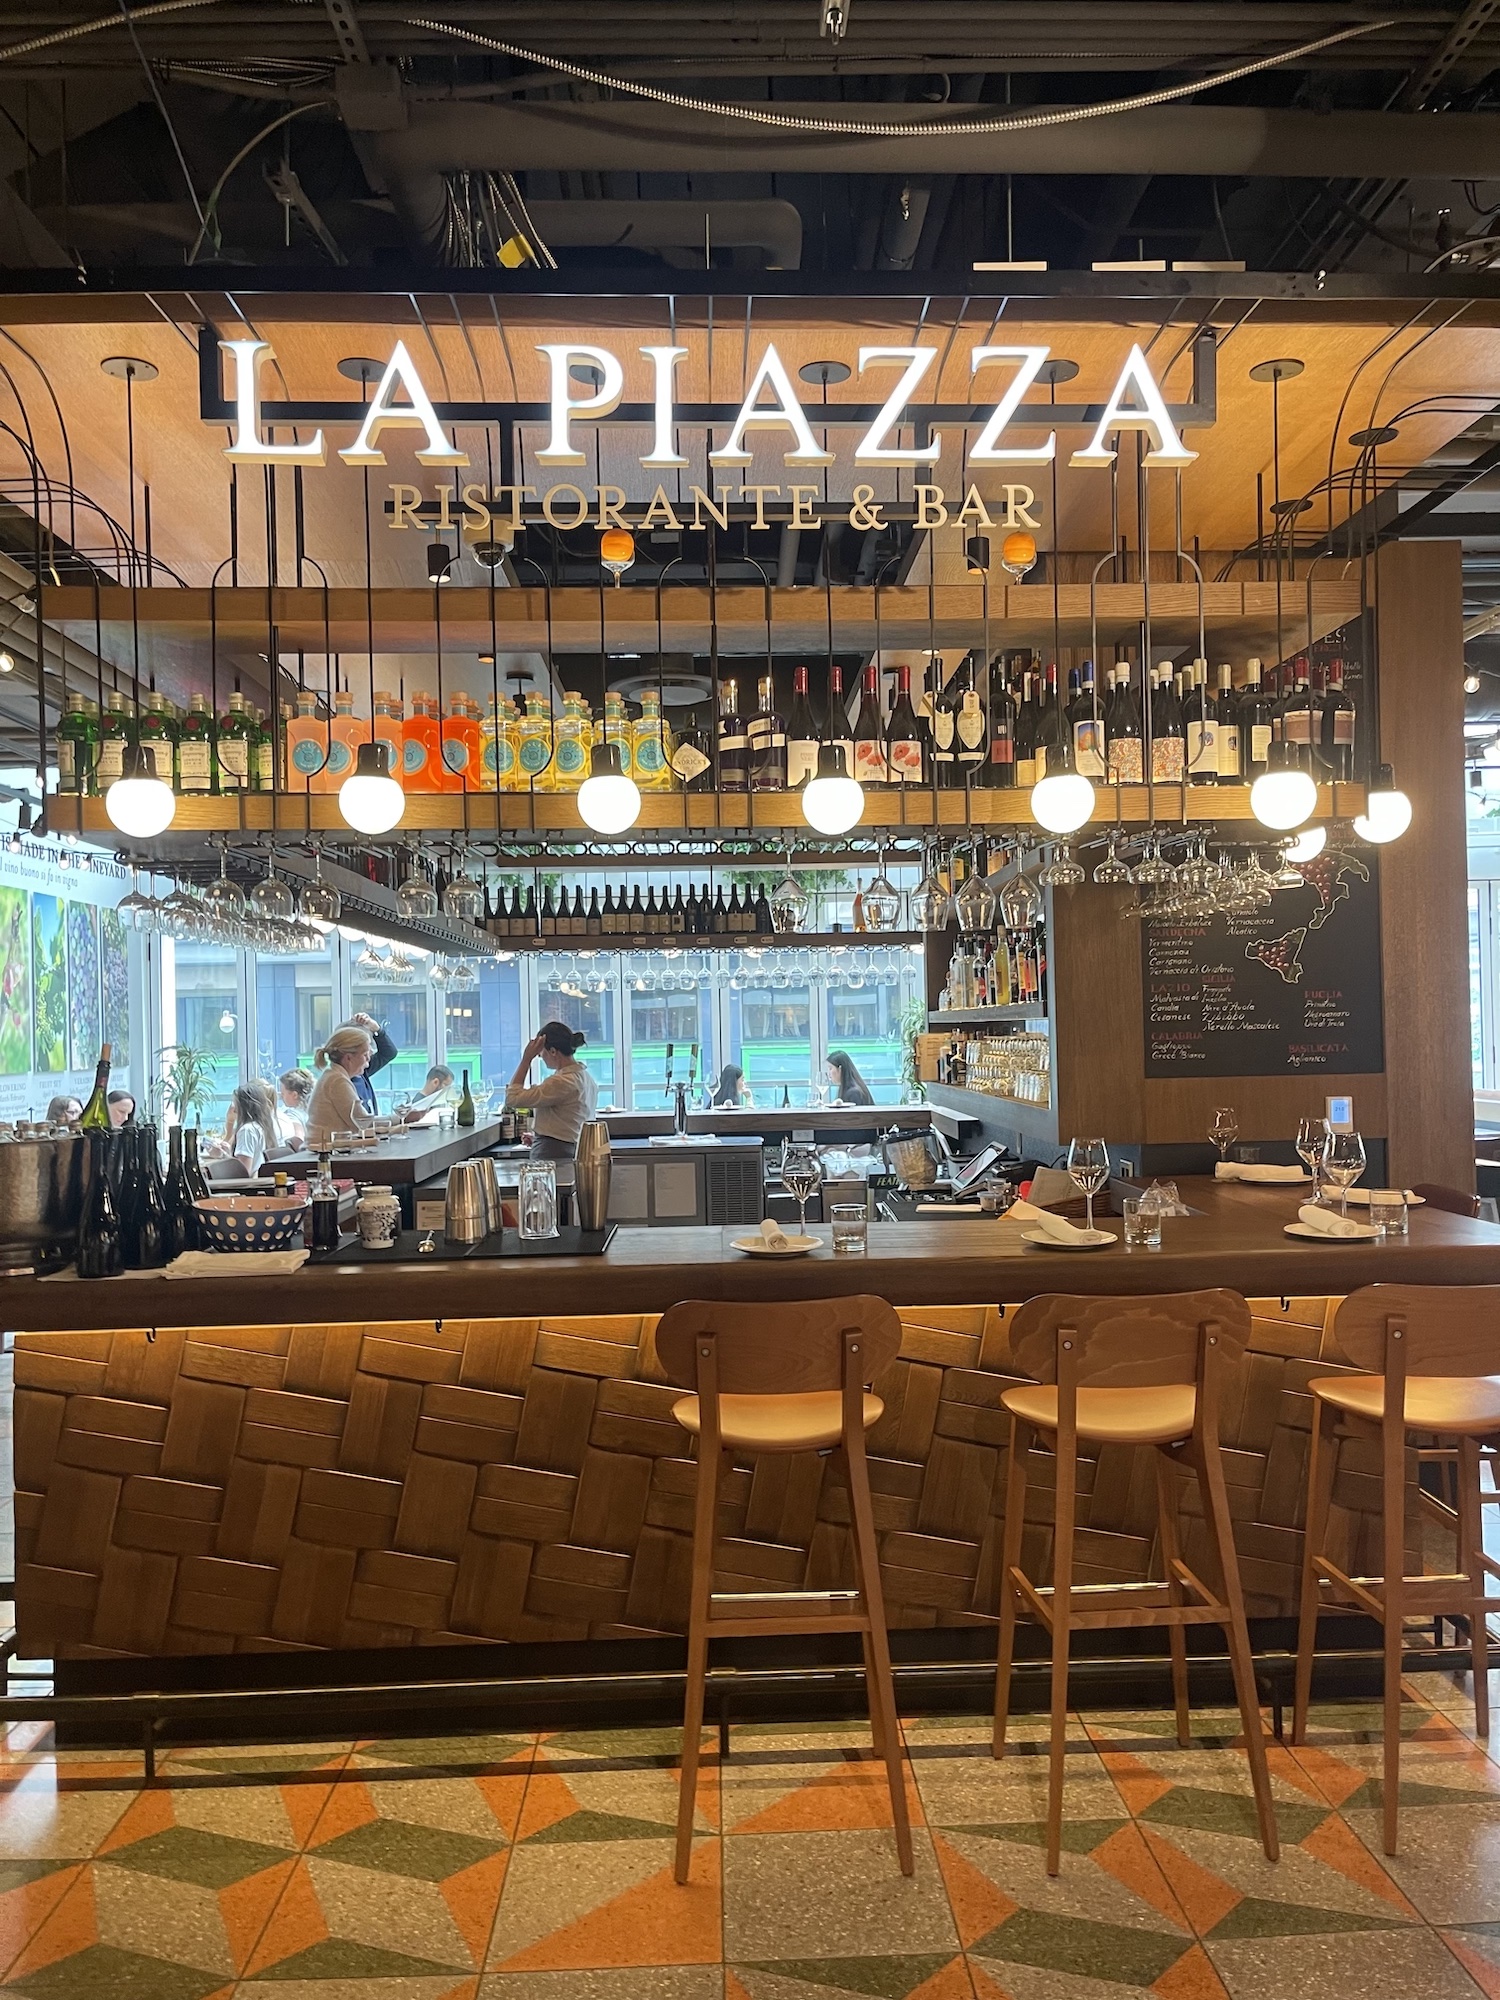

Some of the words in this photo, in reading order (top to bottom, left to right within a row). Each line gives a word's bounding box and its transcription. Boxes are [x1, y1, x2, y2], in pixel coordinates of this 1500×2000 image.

[217, 339, 471, 467] LA
[534, 340, 1200, 468] PIAZZA
[387, 484, 822, 531] RISTORANTE
[848, 484, 888, 531] &
[913, 484, 1042, 530] BAR
[48, 847, 58, 865] IN
[20, 861, 39, 879] buono
[1151, 983, 1191, 992] LAZIO
[1151, 1032, 1204, 1040] CALABRIA
[1288, 1044, 1350, 1053] BASILICATA
